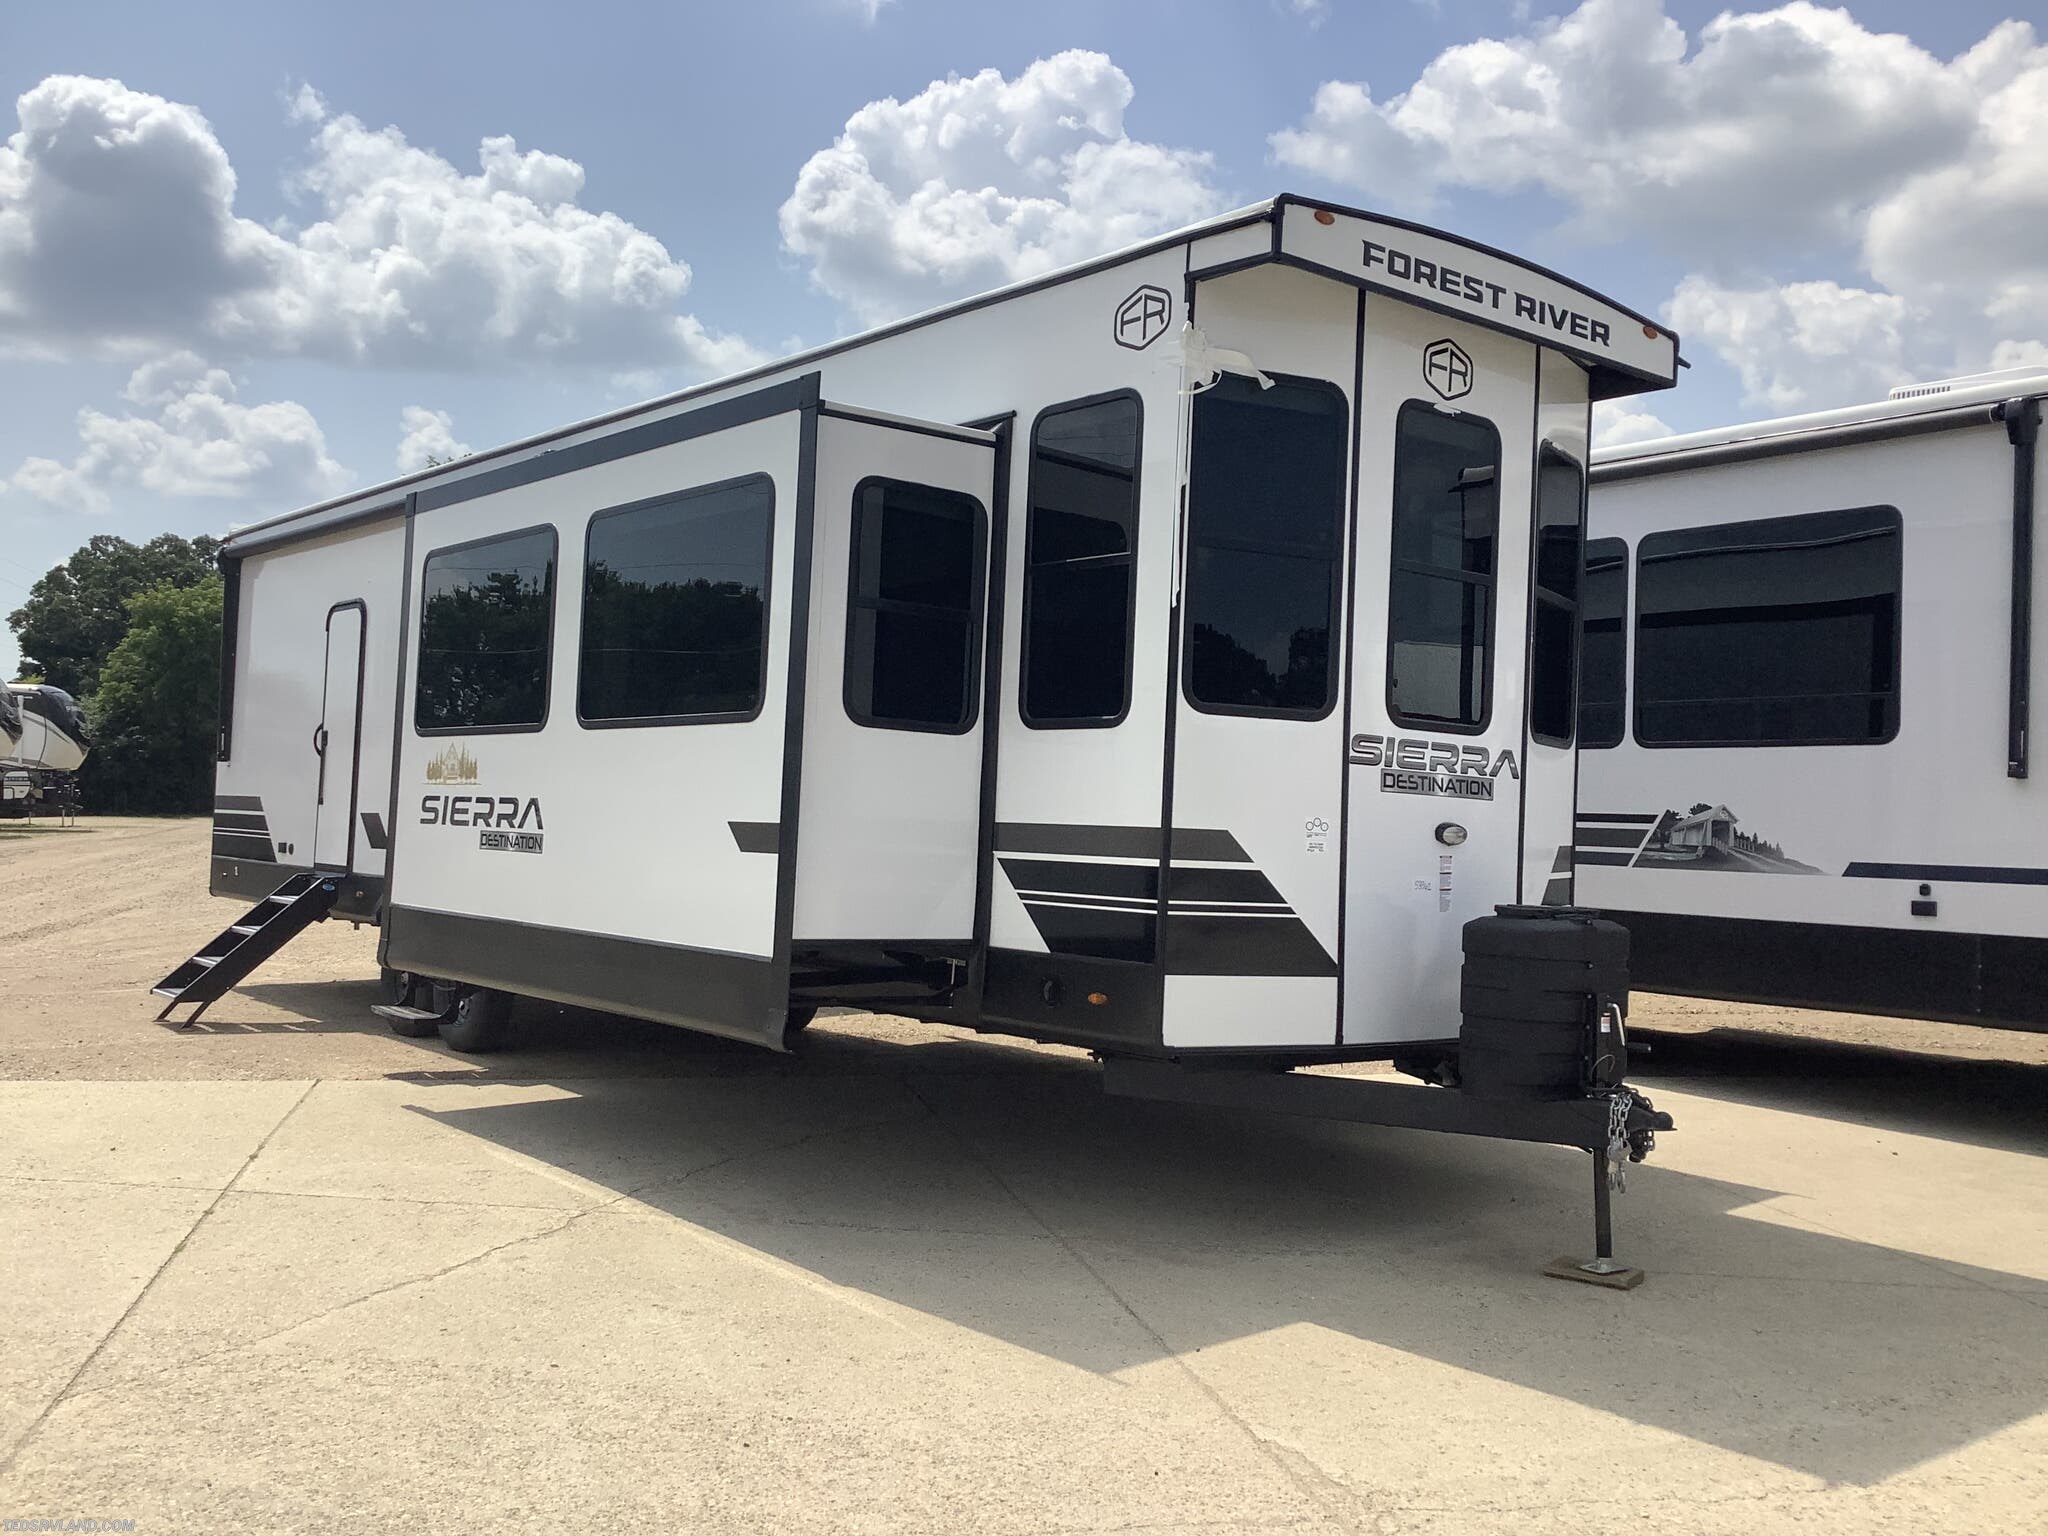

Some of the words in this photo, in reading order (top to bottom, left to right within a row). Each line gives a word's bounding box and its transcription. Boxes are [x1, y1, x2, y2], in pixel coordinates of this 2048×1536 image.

[1361, 239, 1507, 310] FOREST
[1514, 292, 1611, 347] RIVER
[1118, 290, 1168, 343] FR
[1426, 344, 1470, 395] FR
[1350, 733, 1519, 779] SIERRA
[1383, 772, 1492, 797] DESTINATION
[420, 795, 543, 830] SIERRA
[480, 833, 543, 850] DESTINATION
